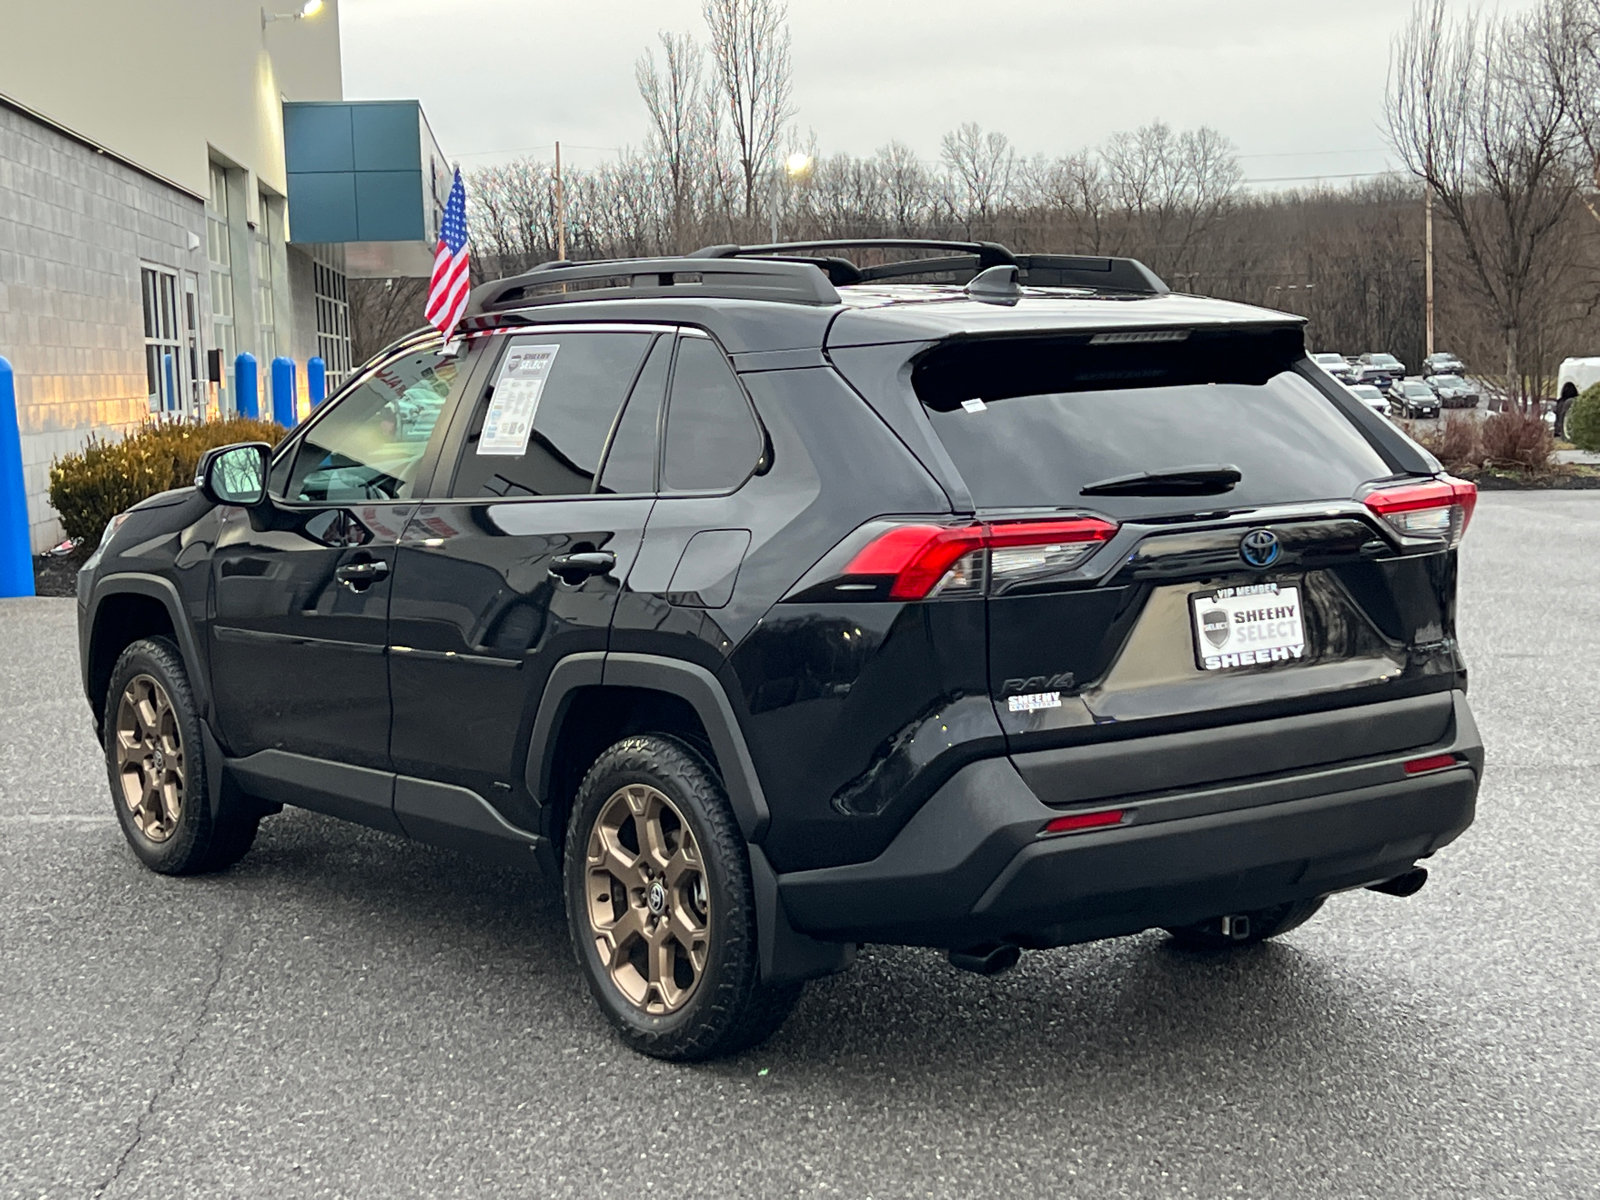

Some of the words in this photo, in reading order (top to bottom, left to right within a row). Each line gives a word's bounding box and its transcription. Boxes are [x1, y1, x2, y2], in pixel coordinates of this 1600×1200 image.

[520, 360, 548, 370] SELECT
[1217, 588, 1235, 599] VIP
[1236, 583, 1278, 596] MEMBER
[1234, 605, 1295, 624] SHEEHY
[1236, 619, 1298, 642] SELECT
[1205, 645, 1304, 670] SHEEHY
[1001, 672, 1075, 695] RAV4
[1008, 691, 1060, 705] SHEEHY
